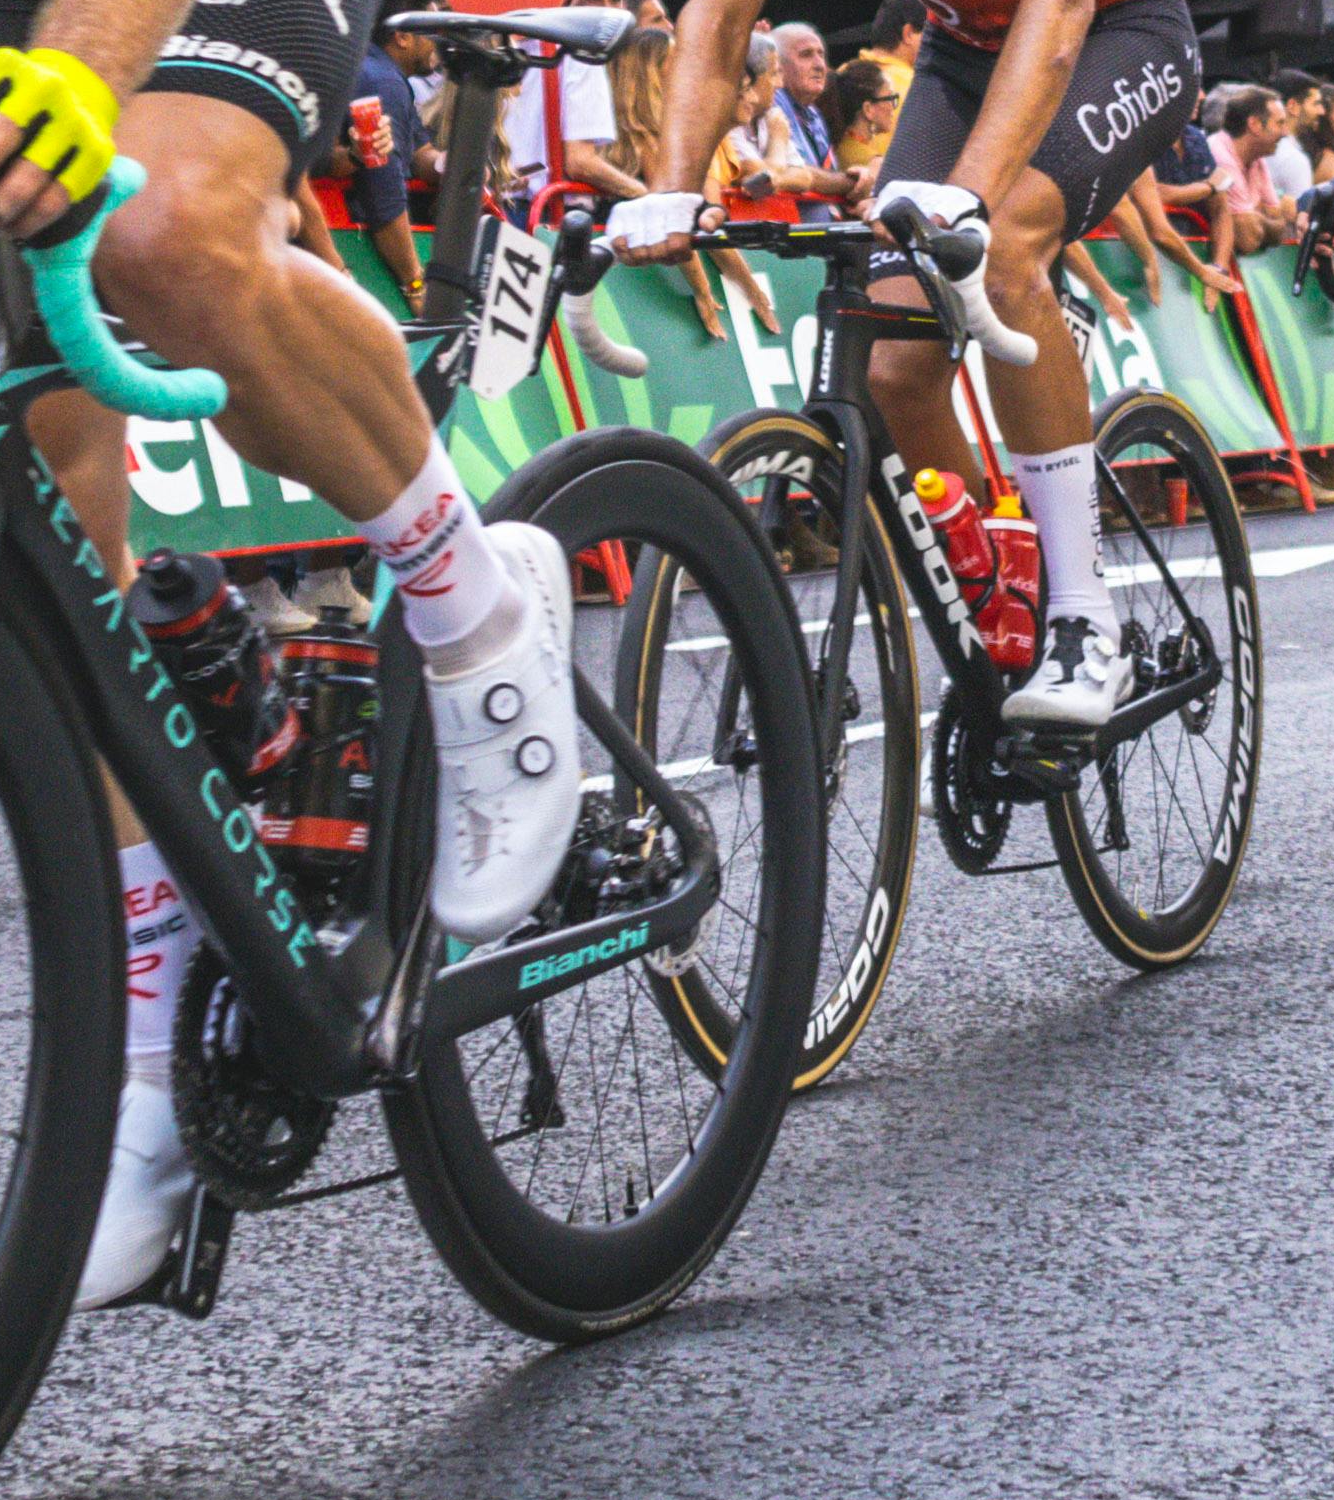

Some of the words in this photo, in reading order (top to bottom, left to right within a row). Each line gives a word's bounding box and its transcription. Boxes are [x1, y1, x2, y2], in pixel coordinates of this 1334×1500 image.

[1076, 62, 1183, 154] Cofidis
[489, 246, 542, 344] 174
[818, 328, 835, 394] LOOK
[880, 452, 989, 661] LOOK
[1212, 585, 1255, 866] CORIMA
[199, 767, 319, 969] CORSE
[518, 922, 650, 991] Bianchi
